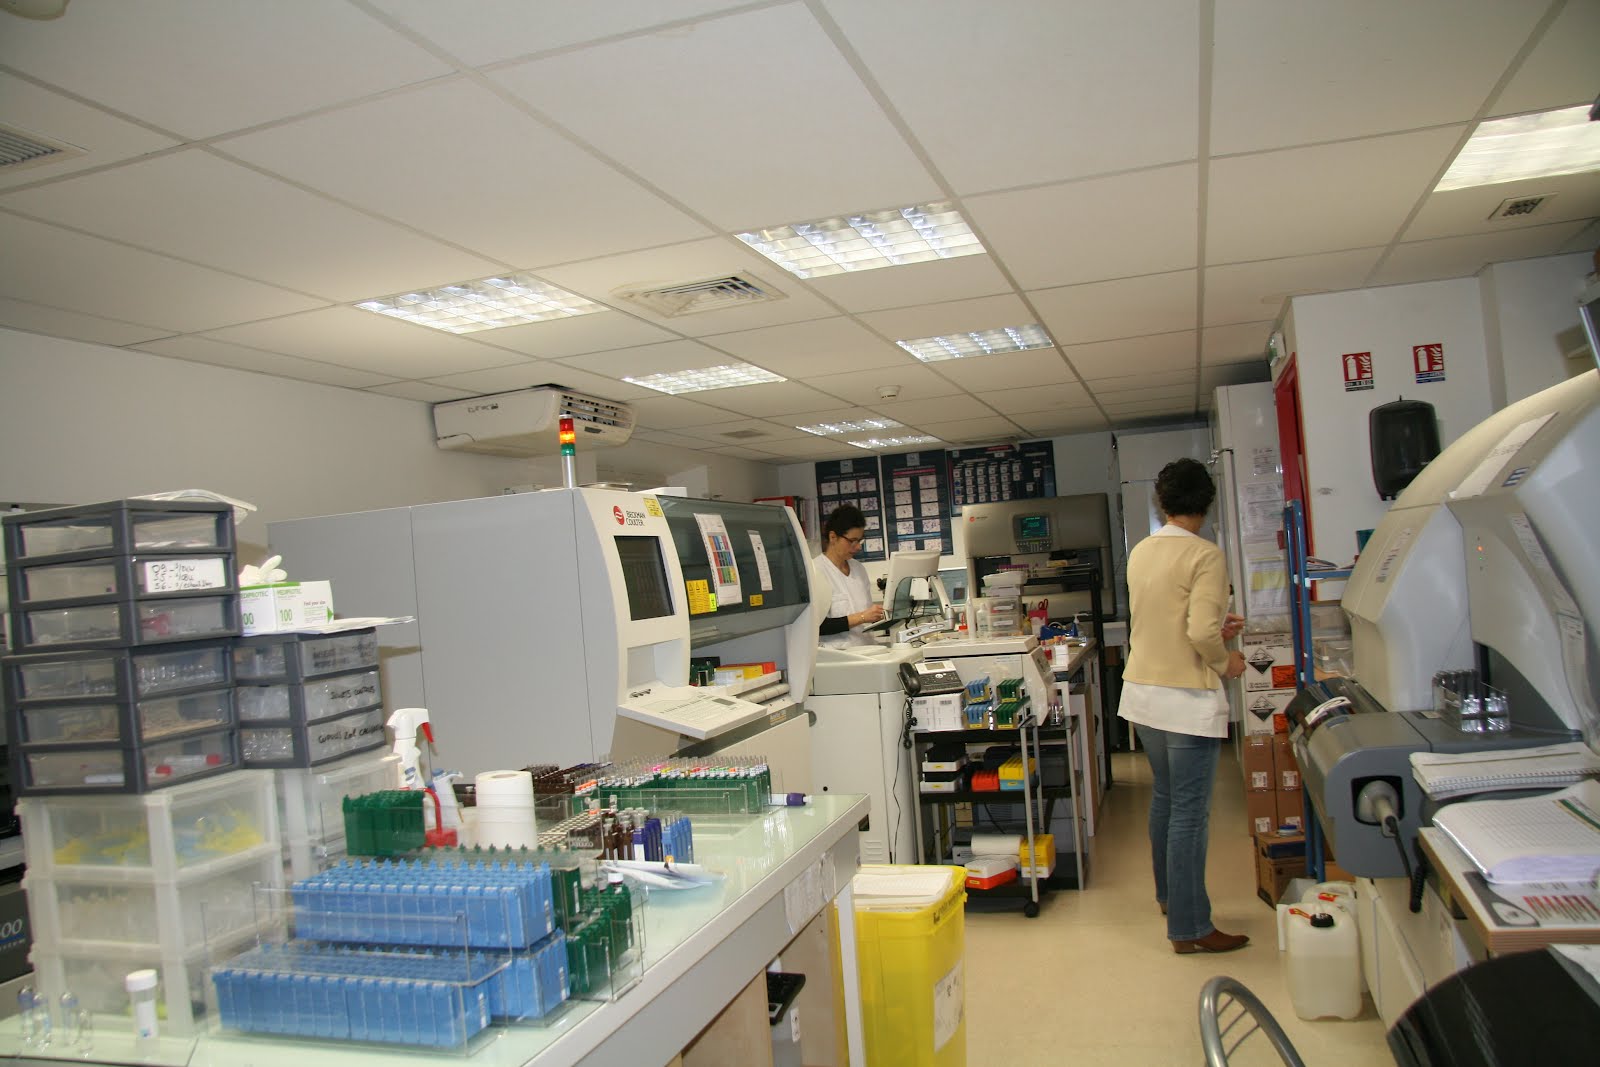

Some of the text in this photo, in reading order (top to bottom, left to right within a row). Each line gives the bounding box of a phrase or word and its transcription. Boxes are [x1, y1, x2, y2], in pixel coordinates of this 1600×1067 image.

[626, 518, 645, 526] COULTER
[241, 590, 269, 598] EDIPROTEC
[243, 612, 254, 625] 00
[280, 609, 293, 622] 100
